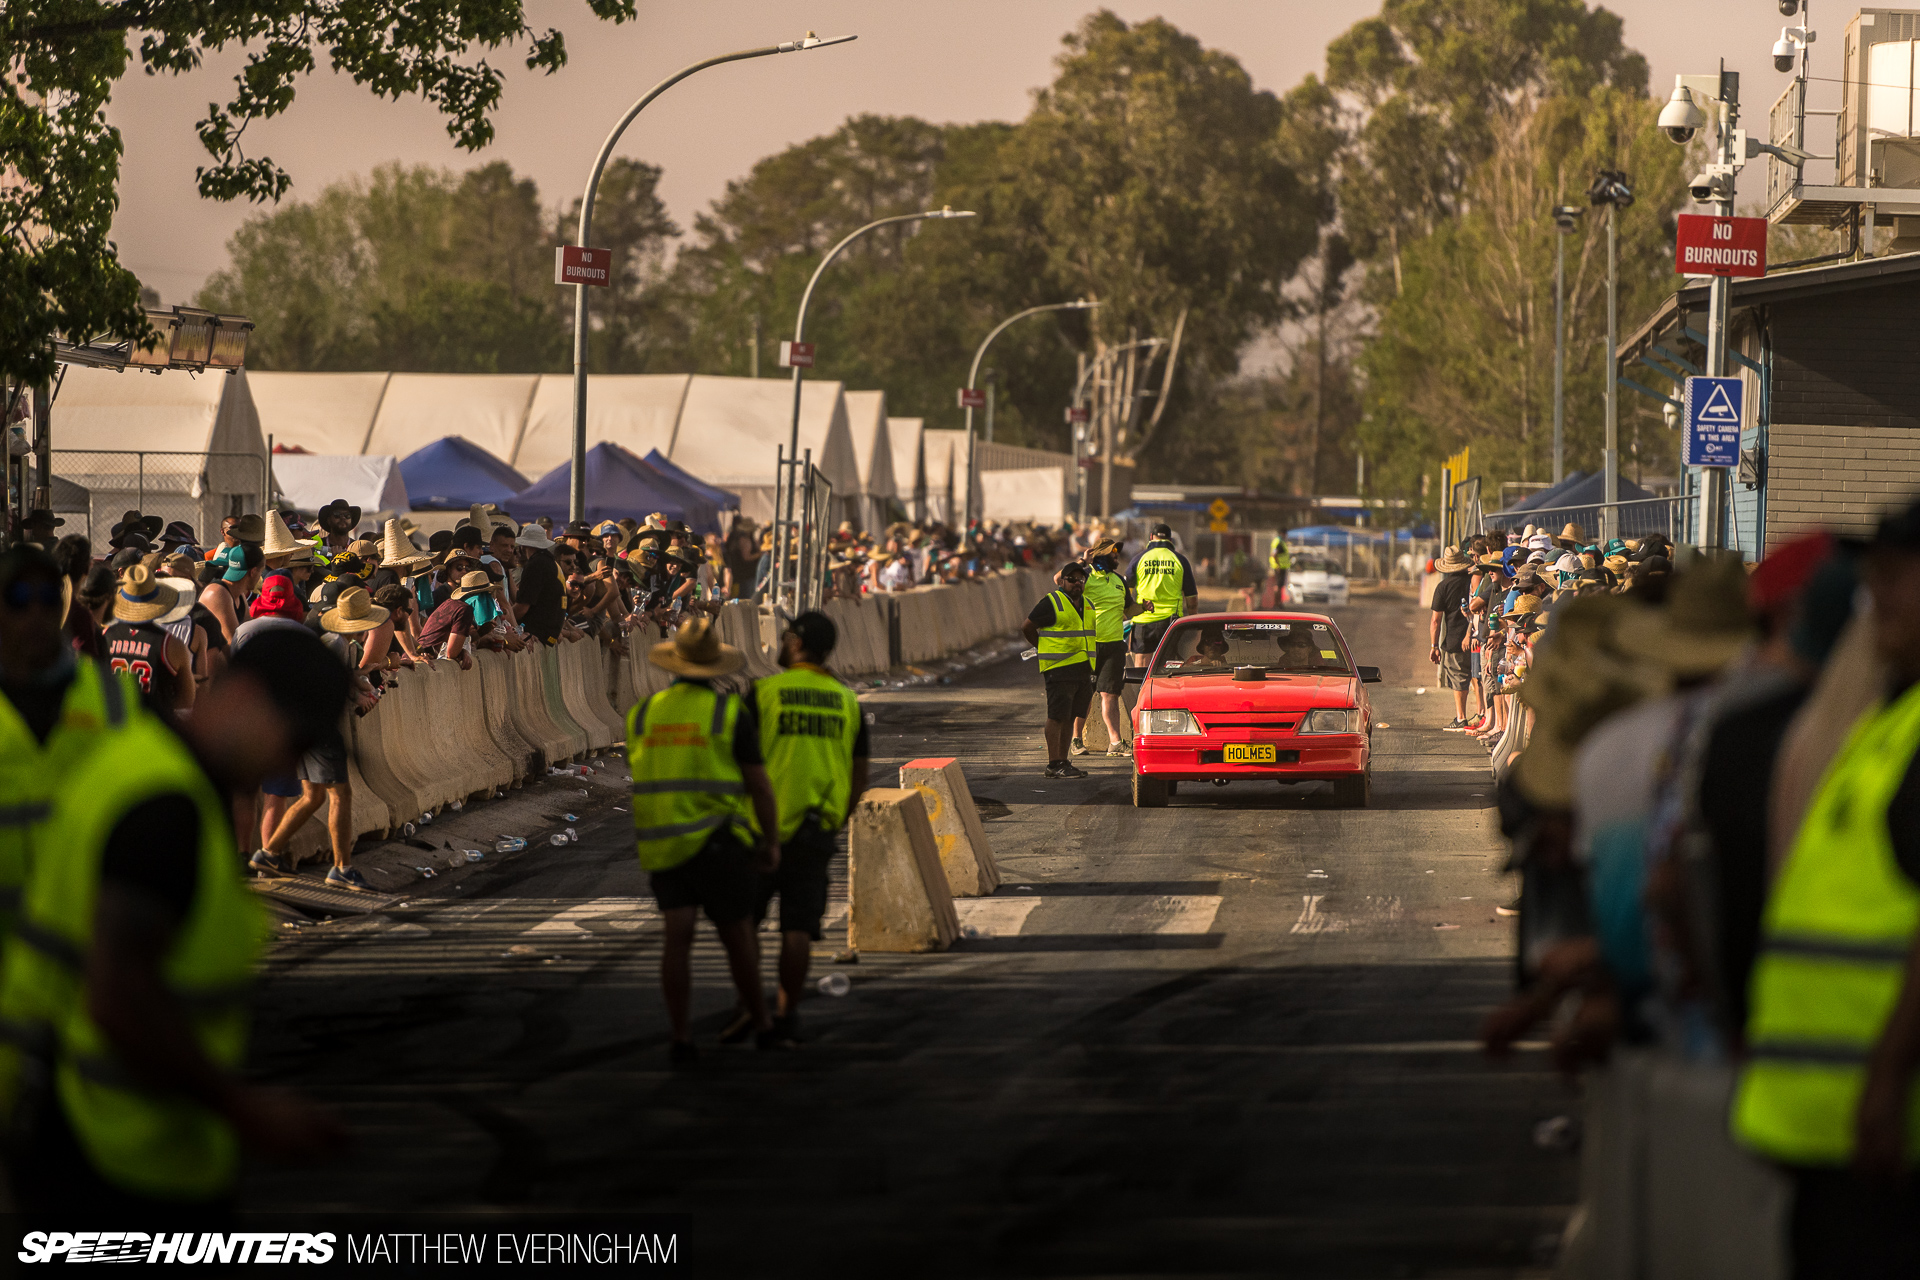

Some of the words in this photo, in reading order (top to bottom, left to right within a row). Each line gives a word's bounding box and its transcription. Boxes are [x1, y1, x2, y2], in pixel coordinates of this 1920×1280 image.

[1712, 223, 1733, 240] NO
[581, 251, 593, 263] NO
[1684, 246, 1758, 267] BURNOUTS
[566, 265, 606, 280] BURNOUTS
[1696, 424, 1716, 432] SAFETY
[1717, 425, 1739, 433] CAMERA
[1699, 433, 1706, 442] IN
[1707, 433, 1720, 442] THIS
[1721, 434, 1736, 443] AREA
[1144, 559, 1175, 567] SECURITY
[1144, 567, 1175, 576] RESPONSE
[109, 639, 151, 657] JORDAN
[1228, 747, 1272, 760] HOLMES
